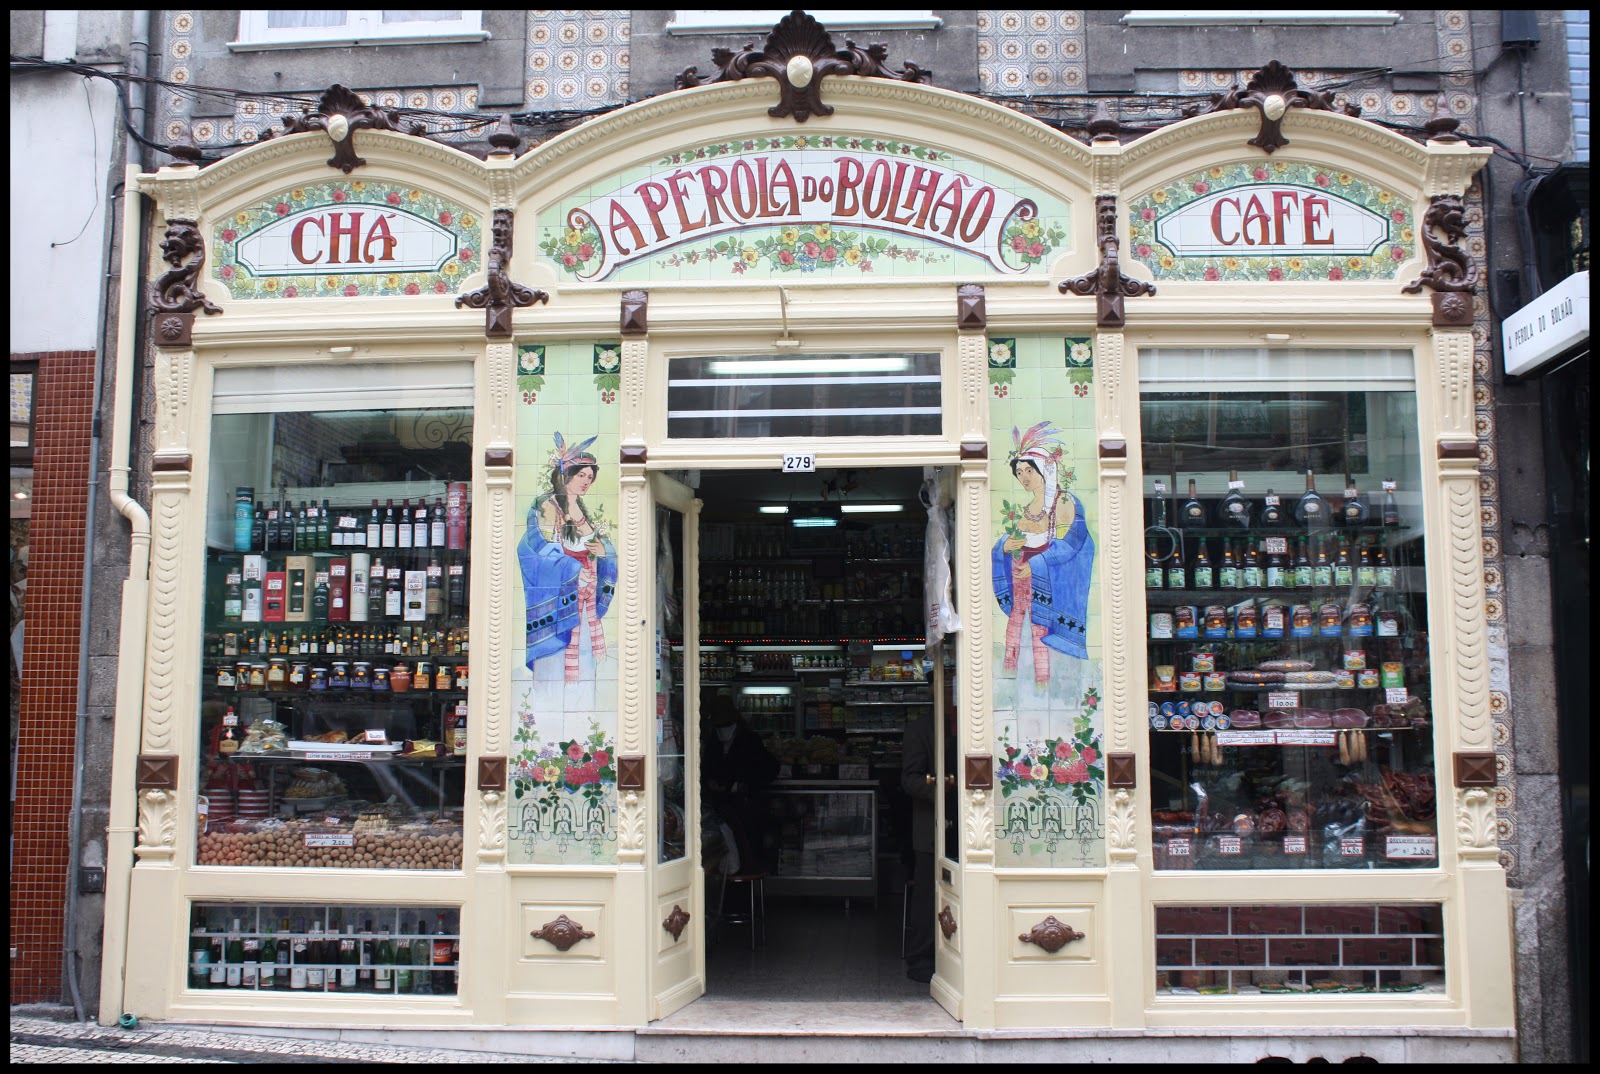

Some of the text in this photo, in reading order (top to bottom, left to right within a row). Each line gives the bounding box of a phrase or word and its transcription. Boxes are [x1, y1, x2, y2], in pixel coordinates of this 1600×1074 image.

[608, 157, 996, 256] A PÉROLA DO BOLHÃO
[1210, 190, 1335, 246] CAFÉ
[290, 212, 398, 265] CHÁ
[1538, 315, 1546, 333] DO
[1551, 296, 1573, 326] BOLHÃO
[786, 456, 811, 469] 279
